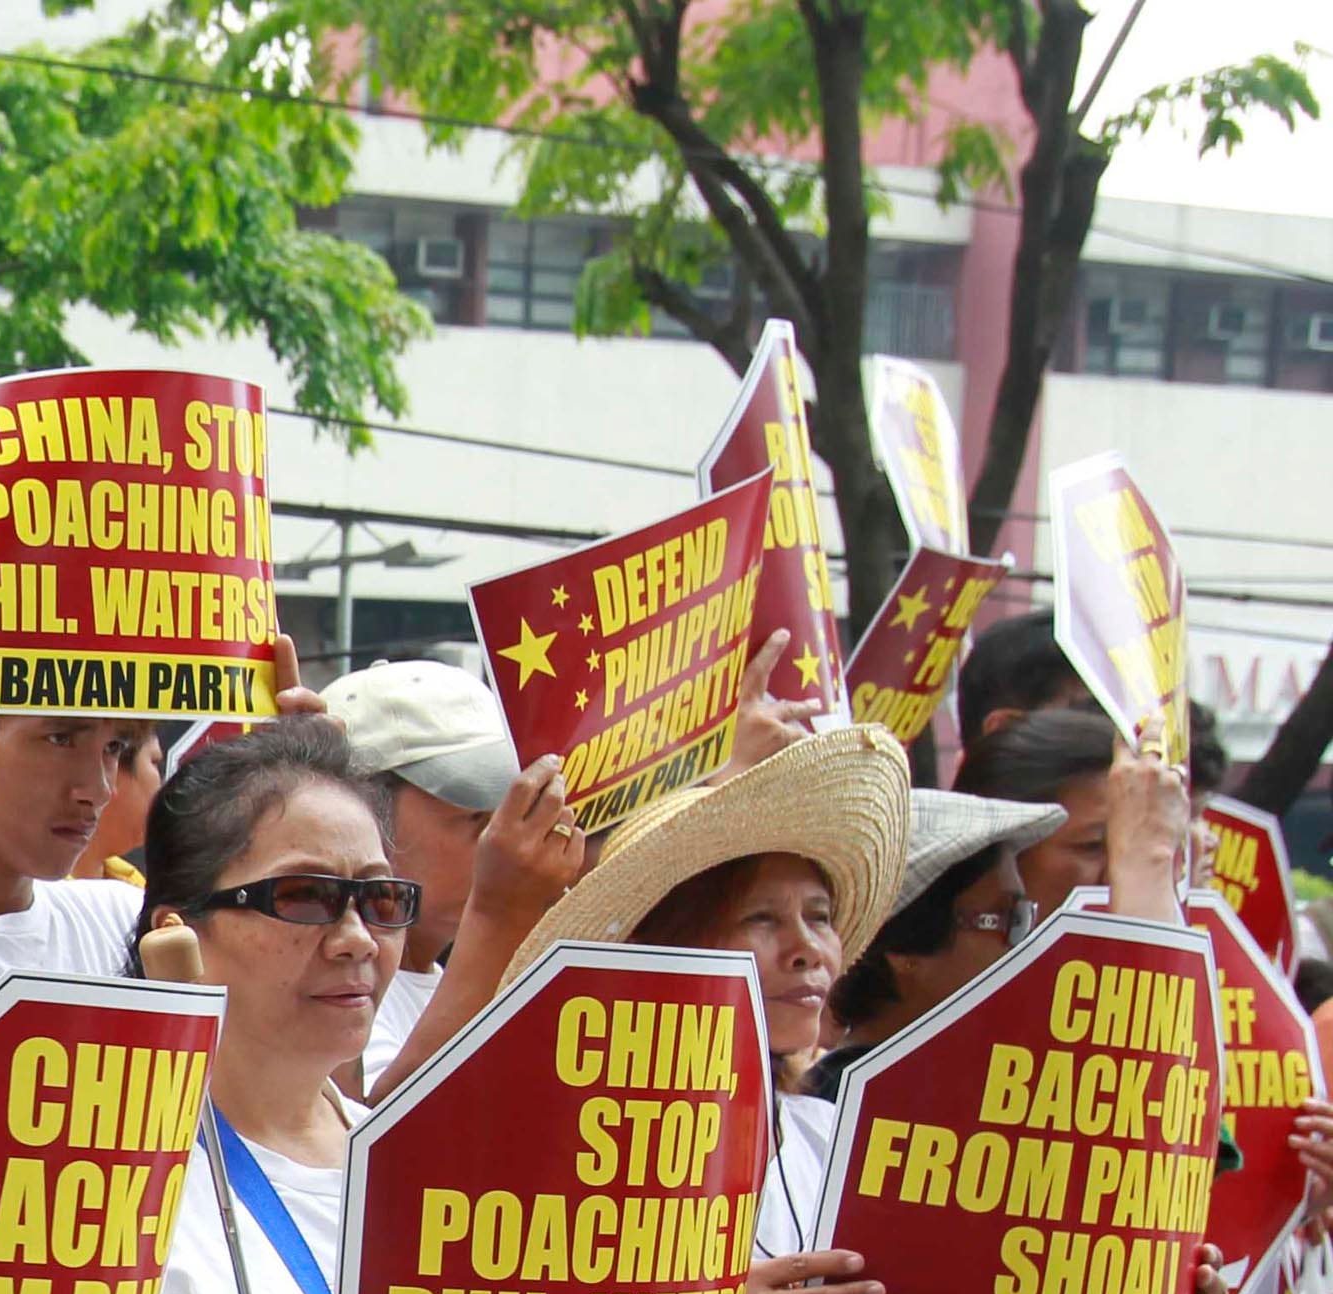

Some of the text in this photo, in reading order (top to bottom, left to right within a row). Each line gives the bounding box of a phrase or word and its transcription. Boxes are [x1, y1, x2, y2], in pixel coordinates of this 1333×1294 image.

[243, 493, 272, 564] IN
[592, 517, 728, 639] DEFEND
[90, 566, 276, 646] WATERS!
[602, 563, 762, 718] PHILIPPINE
[148, 662, 256, 714] PARTY
[558, 640, 748, 796] OVEREIGNTY!
[645, 725, 727, 803] PARTY
[555, 996, 739, 1100] CHINA,
[1049, 960, 1199, 1067] CHINA,
[576, 1097, 721, 1189] STOP
[978, 1042, 1211, 1148] BACK-OFF
[858, 1117, 1075, 1222] FROM
[418, 1187, 728, 1285] POACHING
